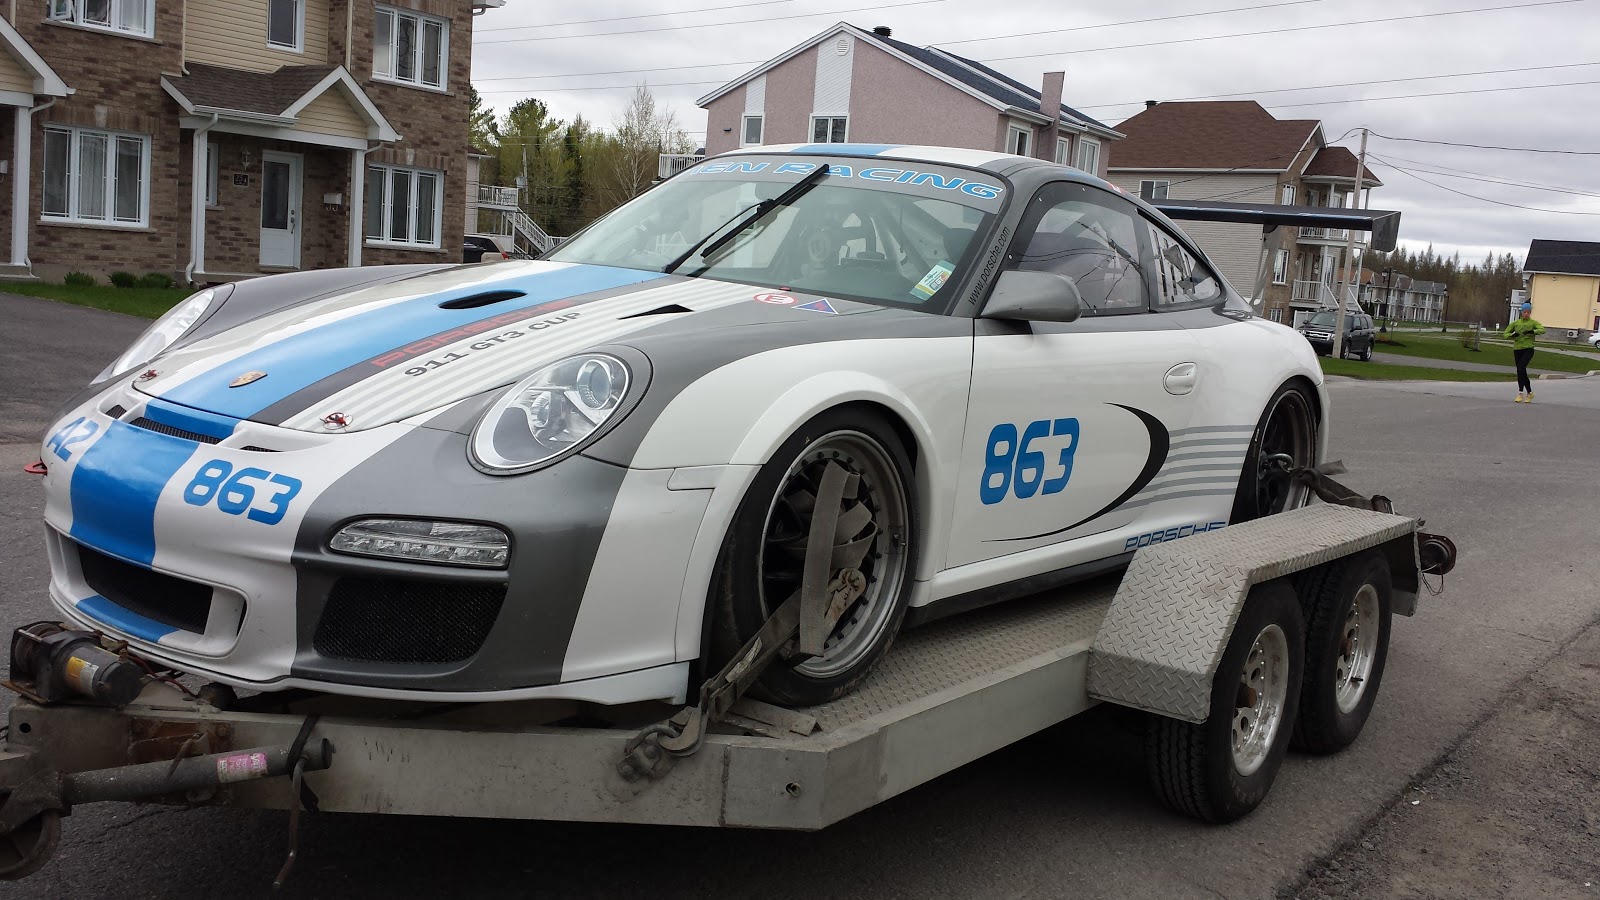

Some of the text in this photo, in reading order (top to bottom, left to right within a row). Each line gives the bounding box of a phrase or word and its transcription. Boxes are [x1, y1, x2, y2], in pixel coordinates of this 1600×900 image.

[773, 162, 1003, 200] RACING
[968, 226, 1011, 306] www.porsche.com
[371, 300, 575, 367] PORSCHE
[405, 312, 580, 377] 911 GT3 CUP
[183, 459, 303, 525] 863
[980, 417, 1079, 505] 863
